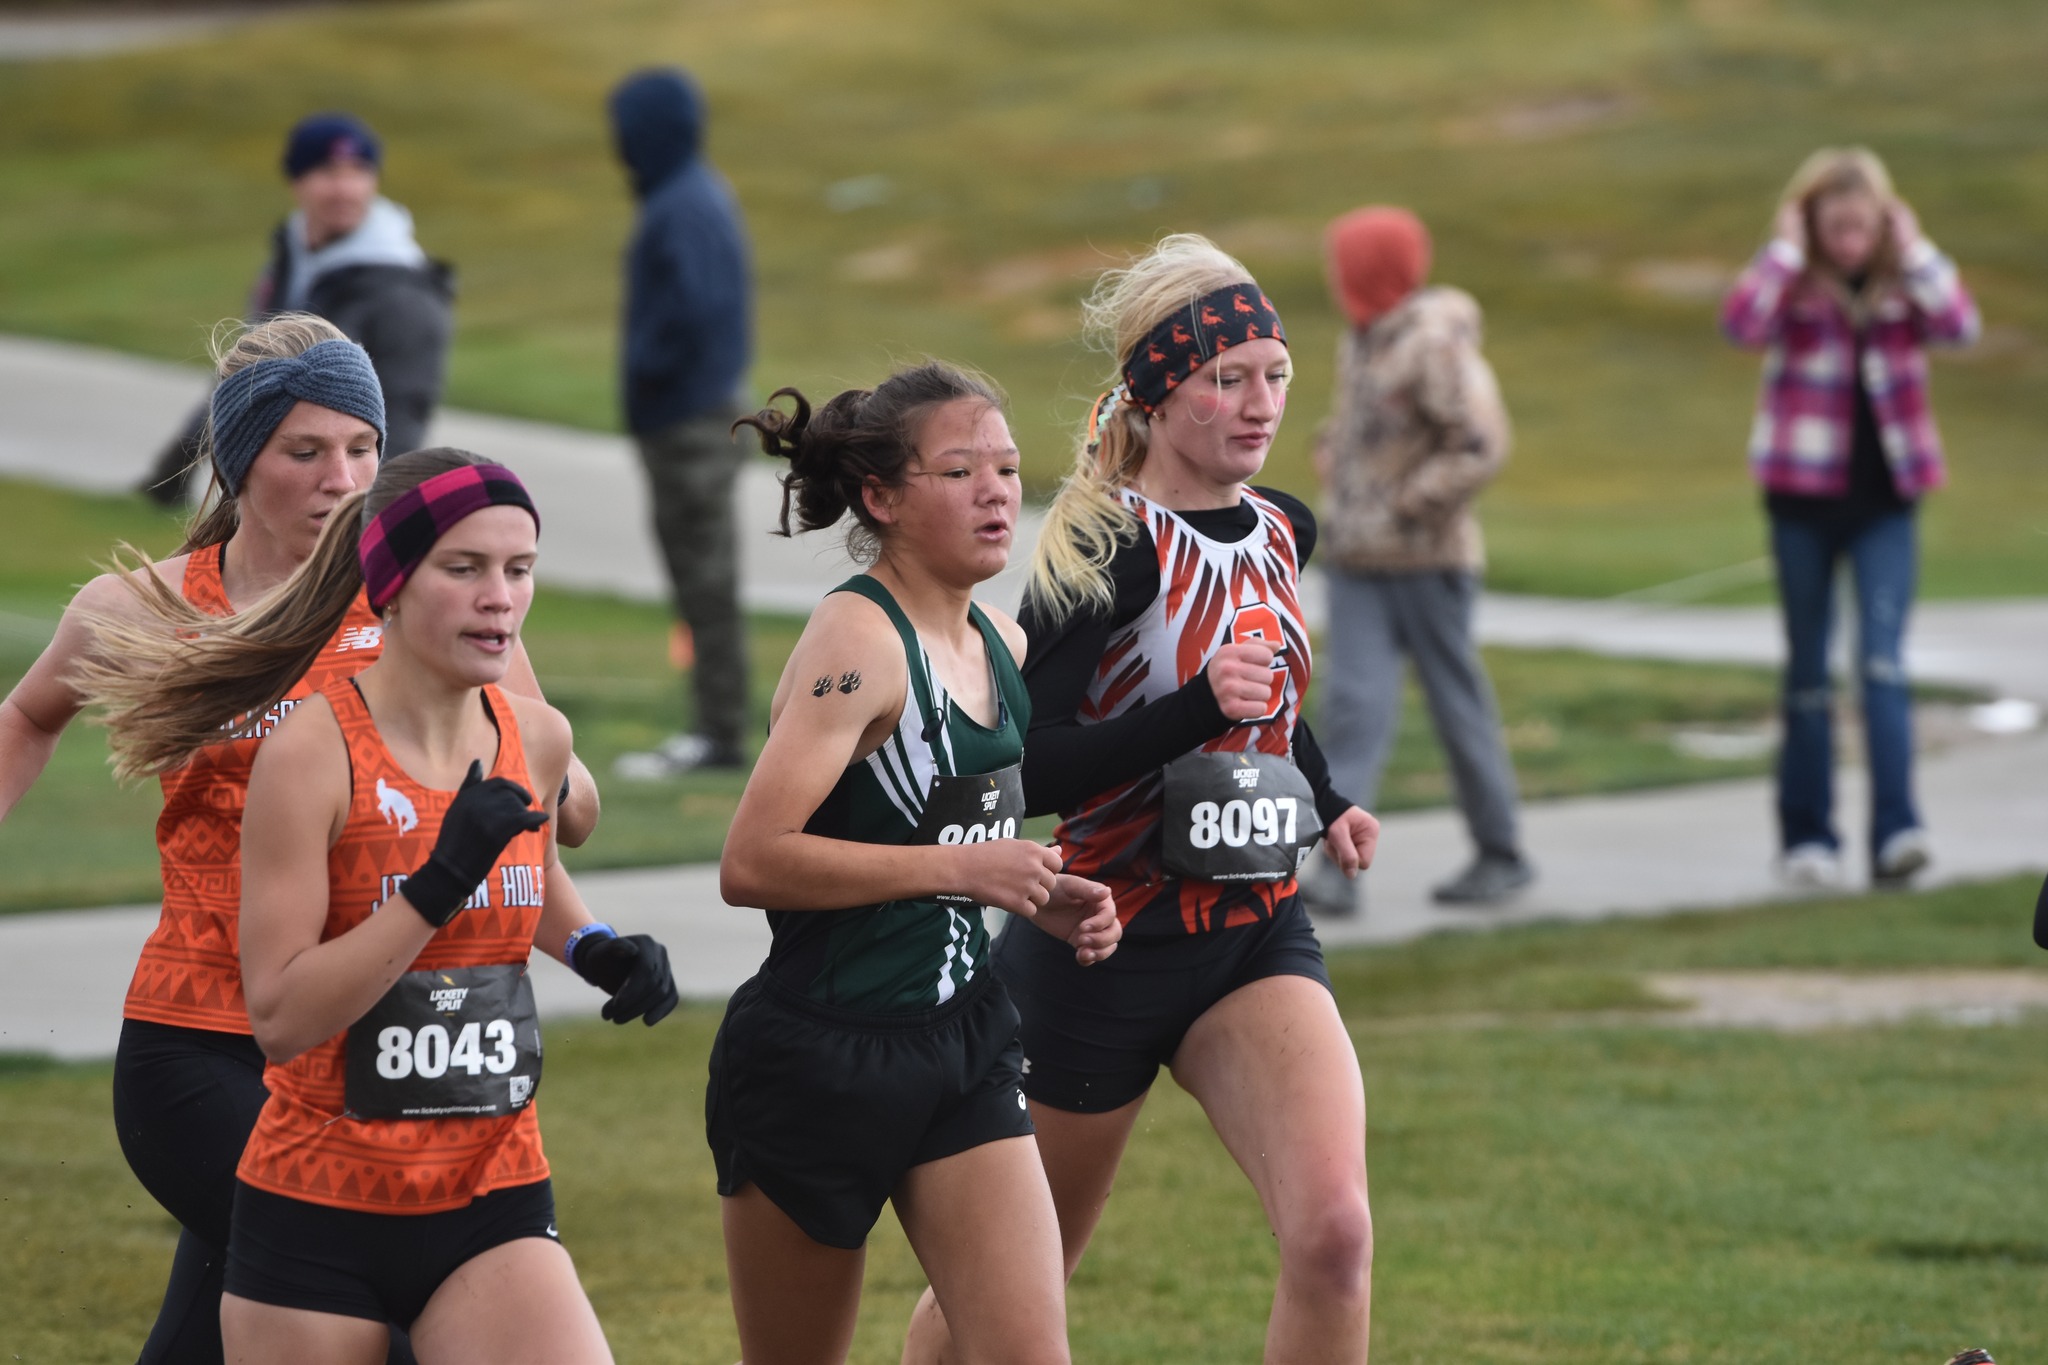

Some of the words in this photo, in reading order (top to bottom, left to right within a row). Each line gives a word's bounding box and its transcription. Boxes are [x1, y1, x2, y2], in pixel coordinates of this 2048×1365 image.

[1233, 768, 1260, 779] LICKETY
[1239, 777, 1258, 788] SPLIT
[981, 790, 1000, 802] LICKETY
[983, 800, 998, 811] SPLIT
[1189, 797, 1298, 849] 8097
[430, 987, 469, 1002] LICKETY
[436, 999, 463, 1011] SPLIT
[376, 1019, 518, 1080] 8043
